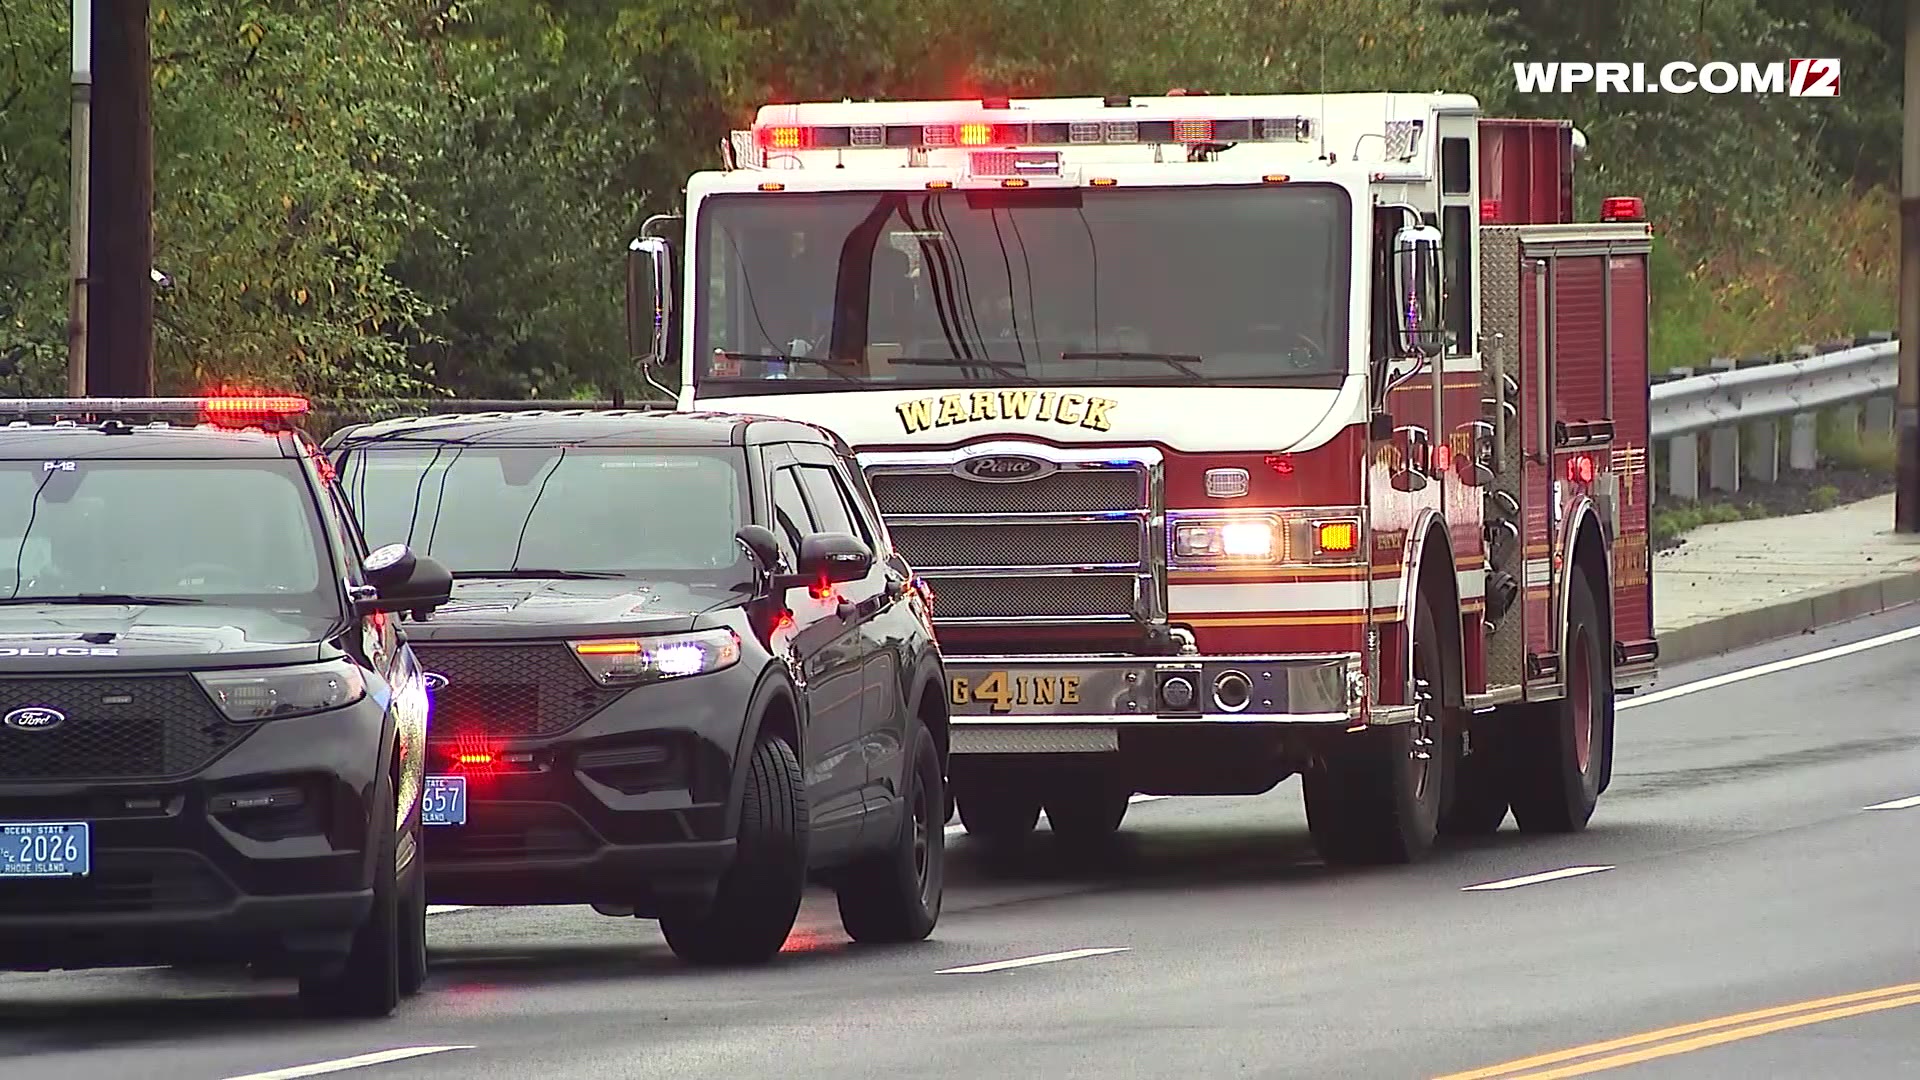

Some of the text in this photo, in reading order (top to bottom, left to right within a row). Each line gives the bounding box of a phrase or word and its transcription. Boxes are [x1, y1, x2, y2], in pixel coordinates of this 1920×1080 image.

[896, 391, 1118, 434] WARWICK
[43, 461, 76, 471] P-12
[972, 458, 1032, 475] Pierce
[18, 712, 51, 725] Ford
[422, 788, 459, 812] 657
[38, 826, 64, 834] STATE
[20, 835, 77, 862] 2026
[5, 864, 64, 872] RHODE ISLAND
